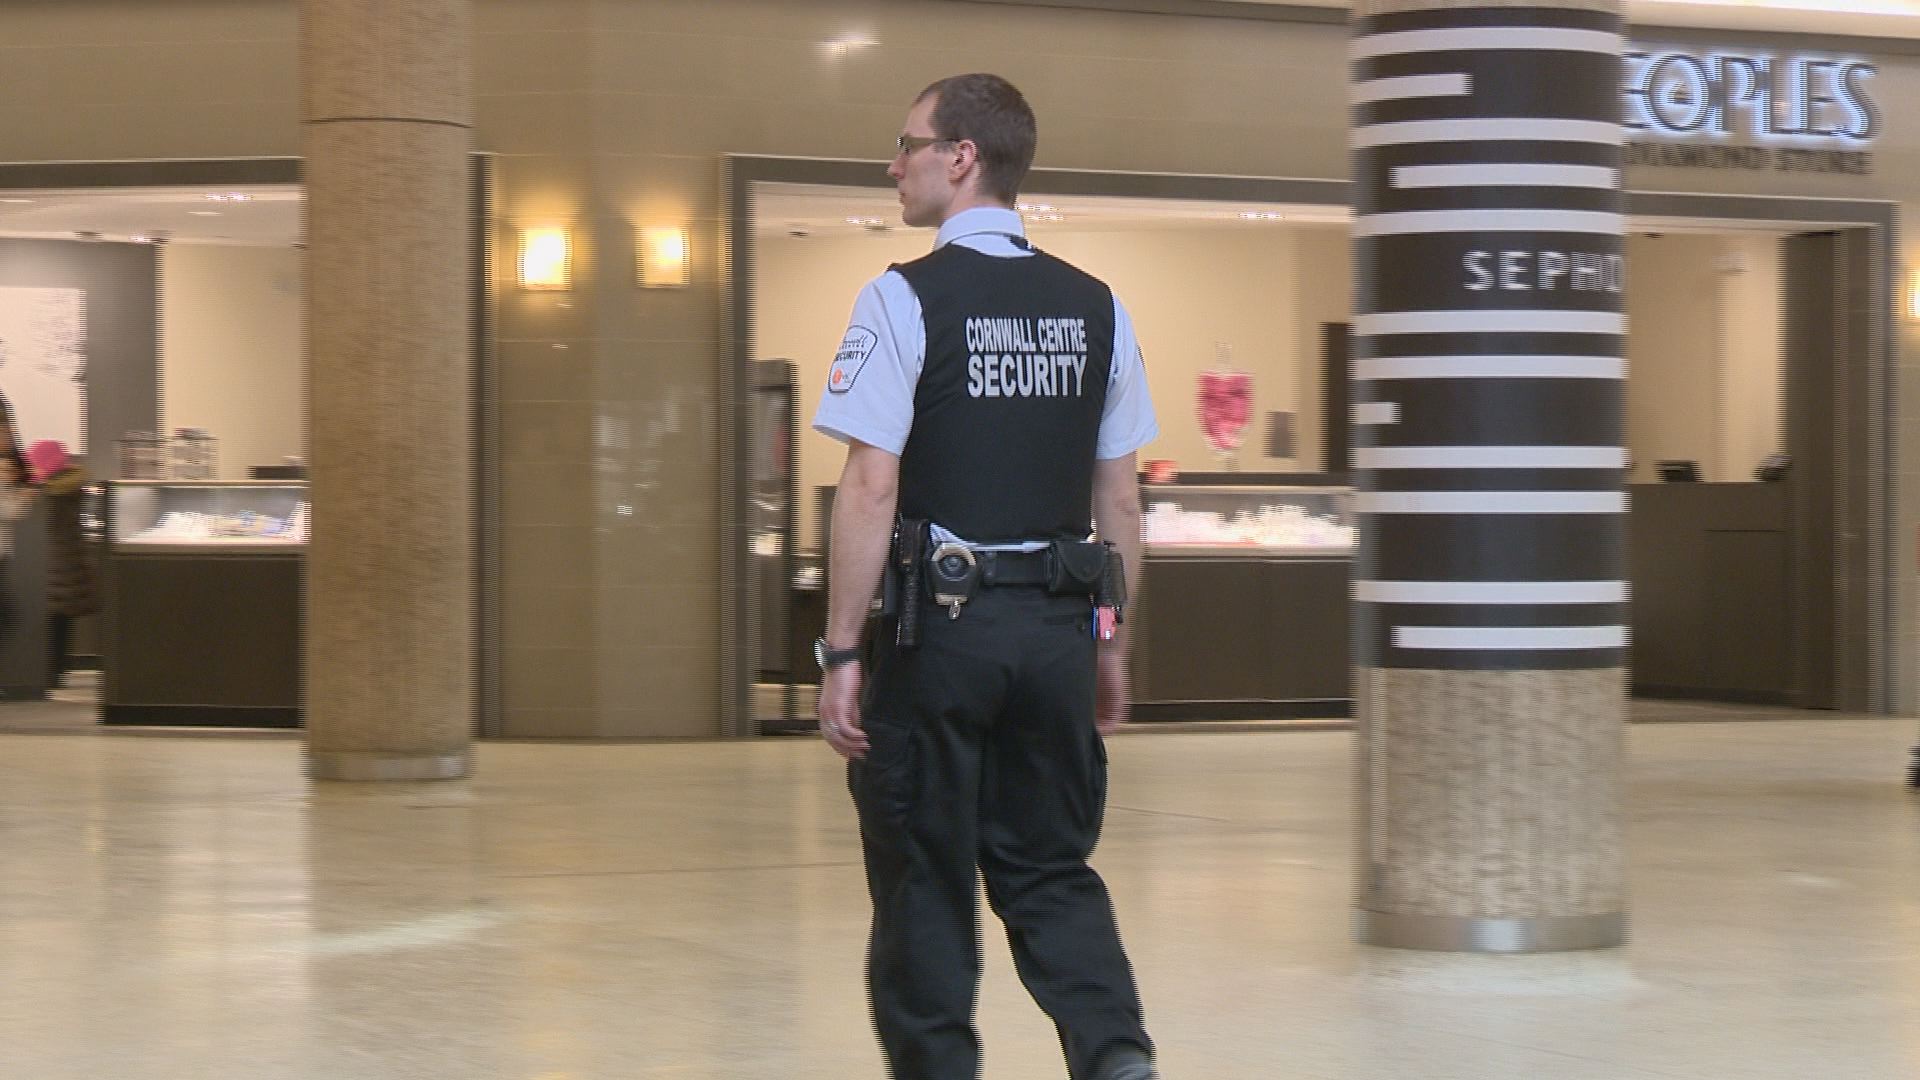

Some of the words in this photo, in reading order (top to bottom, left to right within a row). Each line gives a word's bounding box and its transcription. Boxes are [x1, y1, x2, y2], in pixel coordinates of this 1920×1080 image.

[1622, 141, 1769, 169] DIAMOND
[1774, 148, 1873, 175] STORE
[965, 317, 1036, 353] CORNWALL
[1037, 317, 1088, 353] CENTRE
[967, 353, 1087, 398] SECURITY
